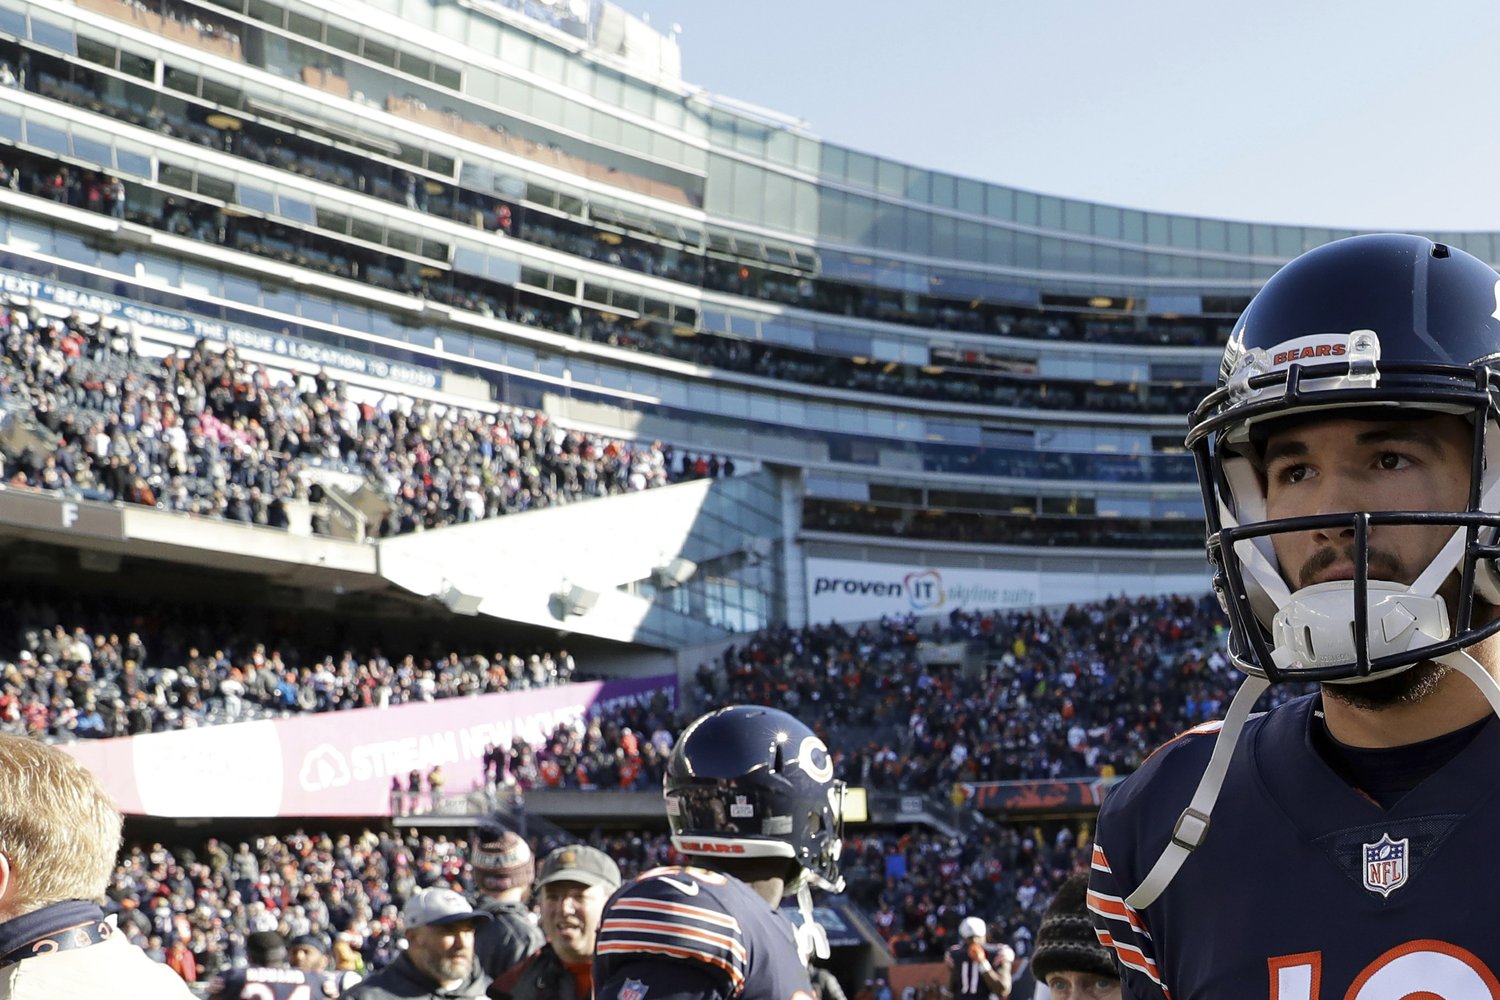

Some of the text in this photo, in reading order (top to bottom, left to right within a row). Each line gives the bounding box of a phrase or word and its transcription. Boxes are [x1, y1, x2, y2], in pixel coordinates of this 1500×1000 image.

[0, 273, 41, 297] TEXT
[193, 319, 224, 340] THE
[227, 325, 273, 351] ISSUE
[274, 337, 288, 354] &
[288, 341, 367, 373] LOCATION
[368, 360, 388, 377] TO
[1273, 343, 1346, 365] BEARS
[62, 502, 79, 528] F
[814, 576, 1035, 605] proven IT skyline suite
[351, 730, 460, 781] STREAM
[460, 719, 514, 761] NEW
[1369, 860, 1401, 886] NFL
[961, 961, 980, 995] 11
